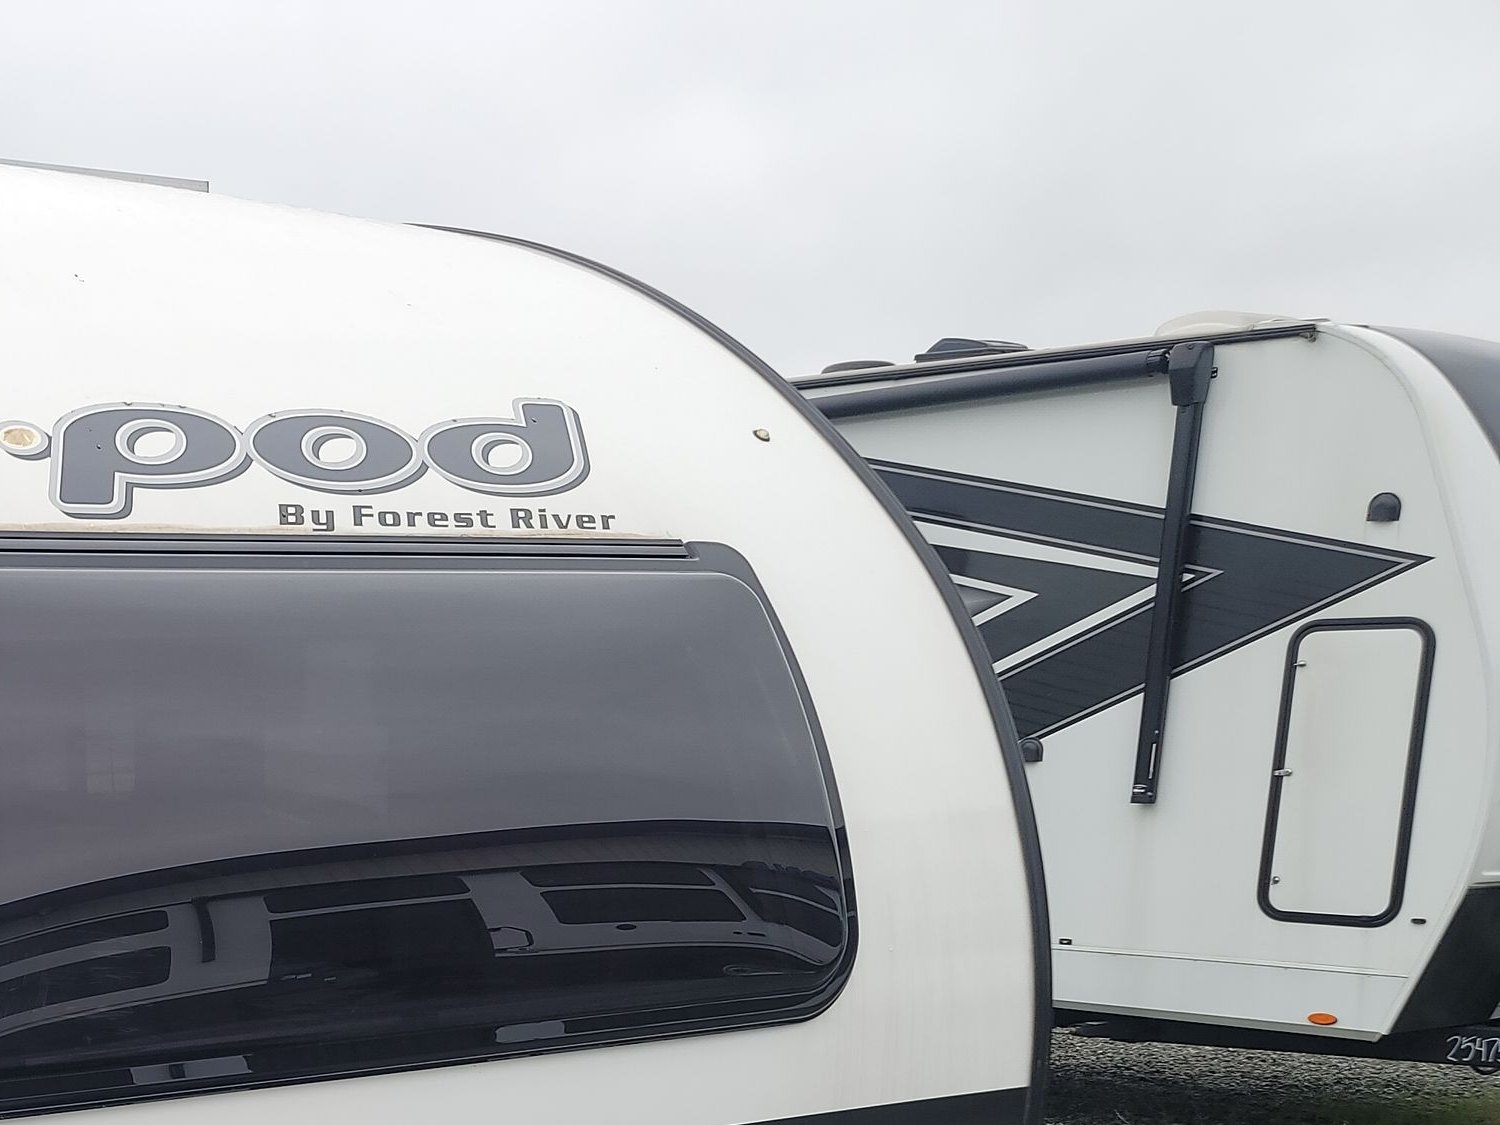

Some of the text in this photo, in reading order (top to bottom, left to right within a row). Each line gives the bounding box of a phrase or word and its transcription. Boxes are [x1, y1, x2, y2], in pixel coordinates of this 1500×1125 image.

[278, 502, 617, 532] By Forest River
